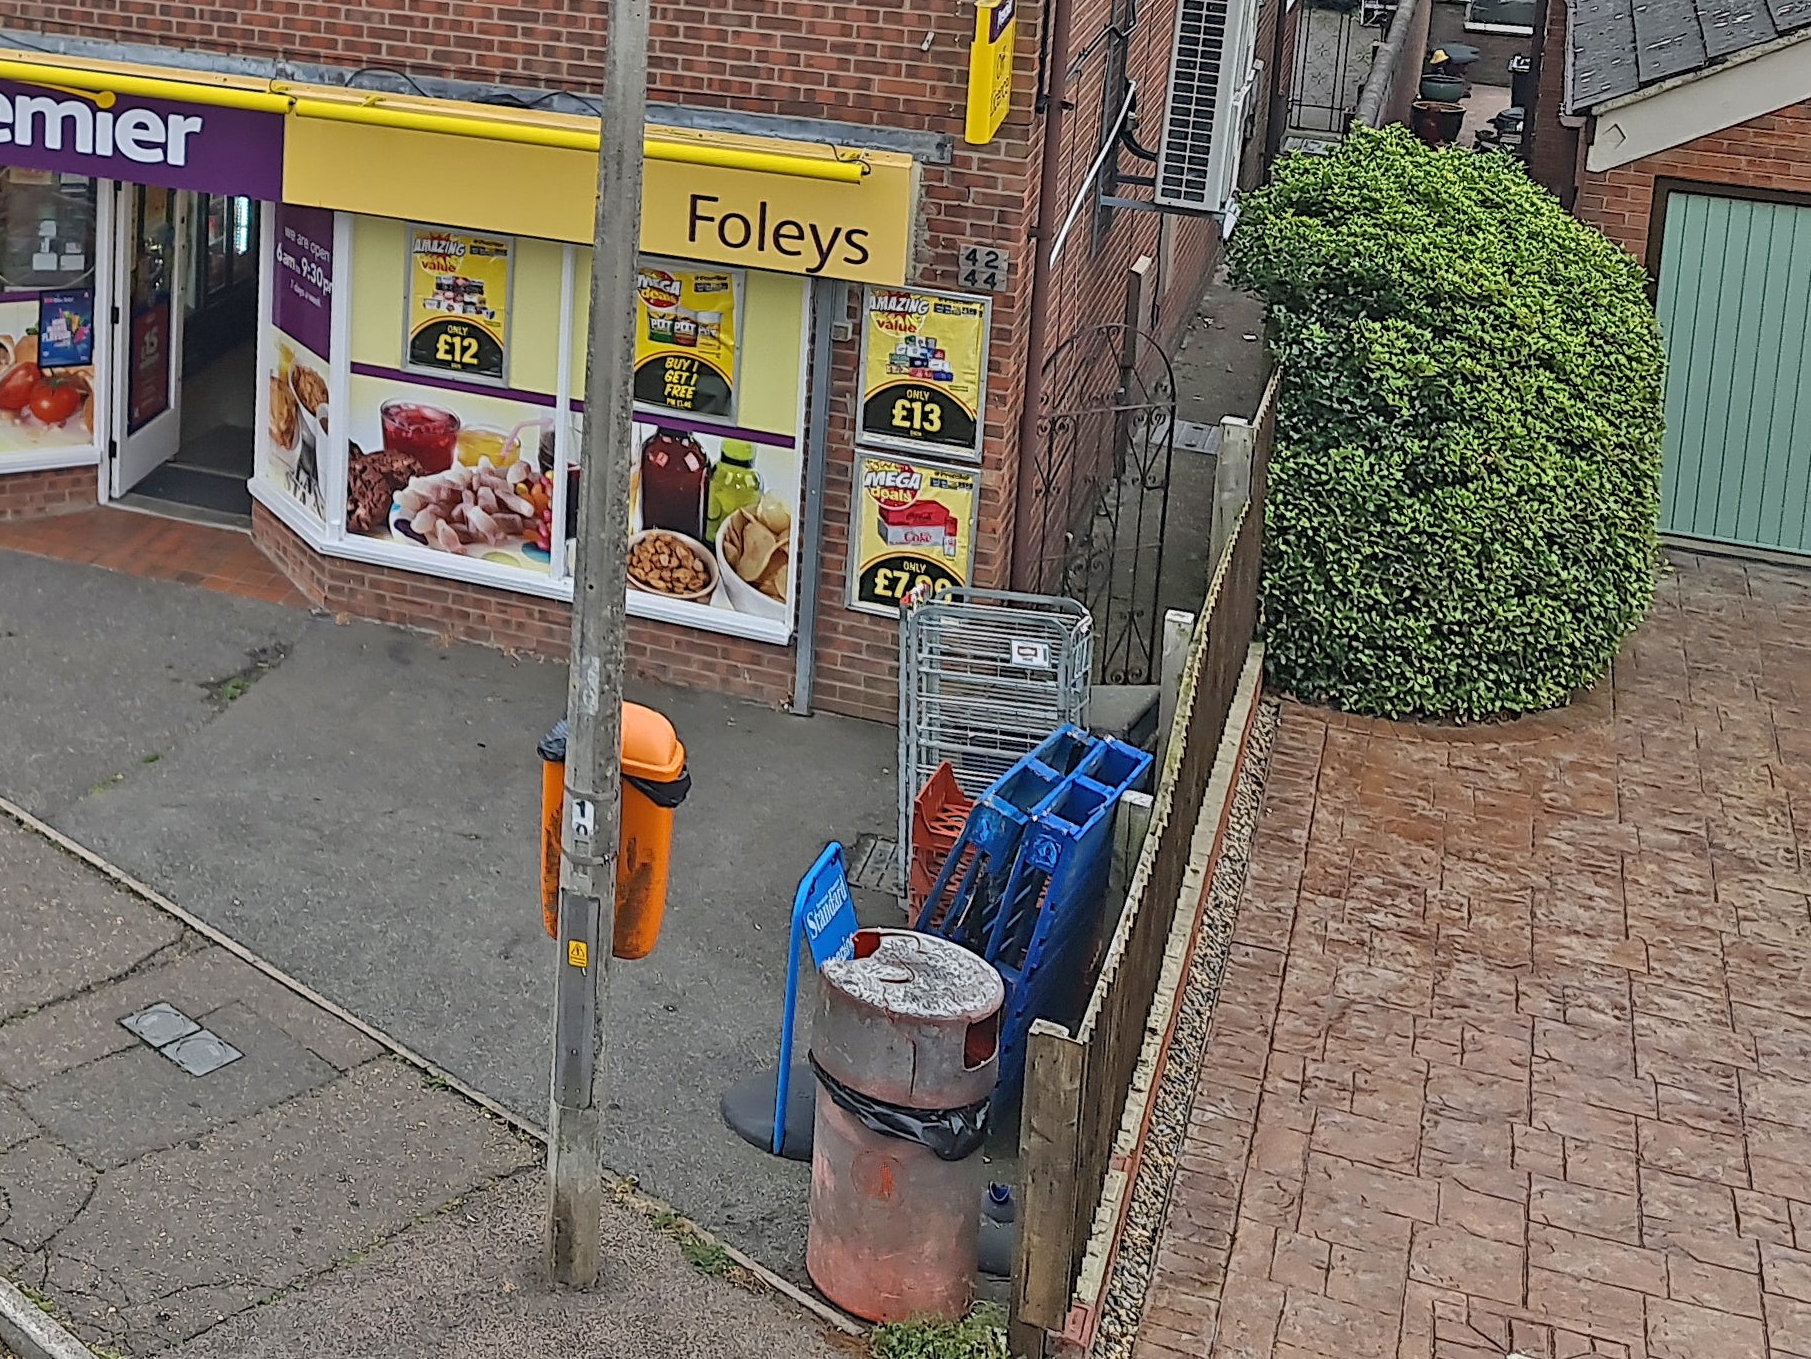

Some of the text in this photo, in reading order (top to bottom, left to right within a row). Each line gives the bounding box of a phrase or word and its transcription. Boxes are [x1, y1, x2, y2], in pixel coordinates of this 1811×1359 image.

[689, 194, 869, 273] Foleys
[285, 226, 330, 262] we are open
[413, 239, 465, 256] AMAZING
[421, 260, 456, 273] value
[638, 274, 682, 296] MEGA
[869, 295, 930, 315] AMAZING
[447, 324, 468, 336] ONLY
[876, 319, 917, 333] value
[436, 333, 478, 365] £12
[665, 357, 691, 371] BUY
[664, 370, 689, 384] GET
[664, 384, 696, 399] FREE
[906, 389, 931, 402] ONLY
[891, 399, 942, 432] £13
[864, 471, 922, 490] MEGA
[870, 488, 914, 503] deals
[903, 561, 927, 574] ONLY
[874, 568, 952, 604] £799
[806, 873, 848, 941] Standard
